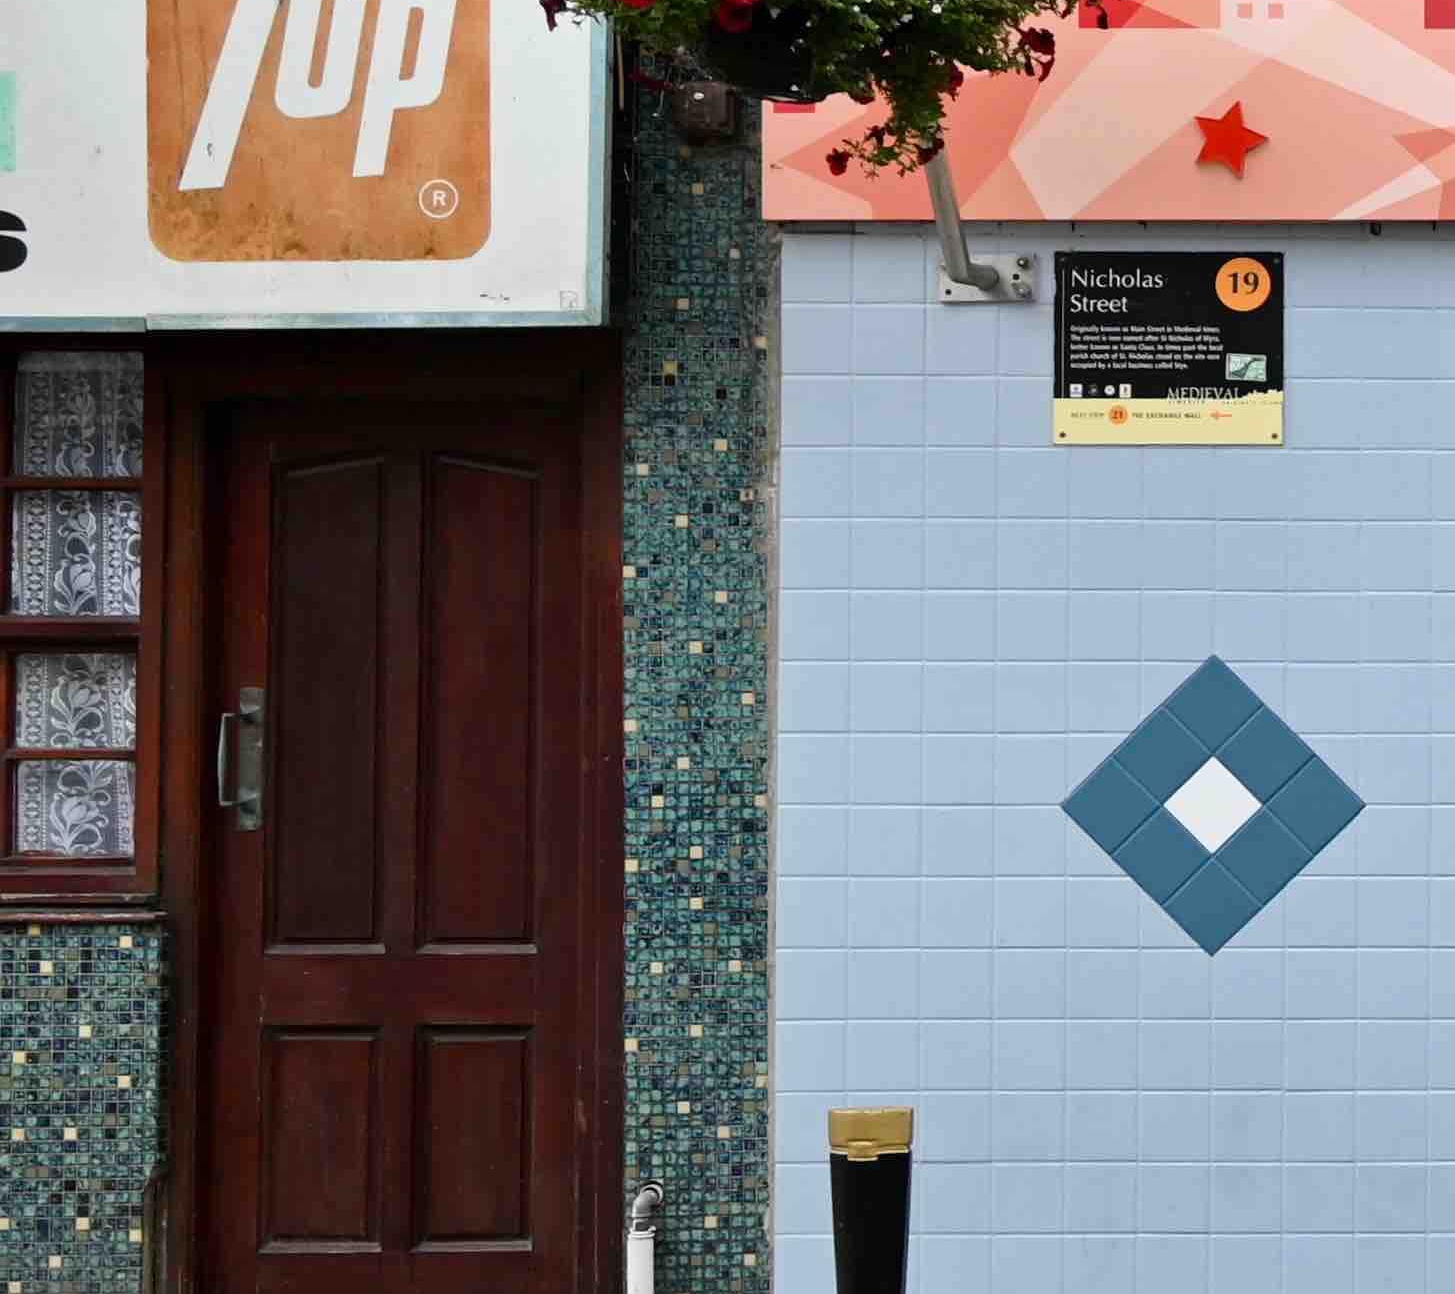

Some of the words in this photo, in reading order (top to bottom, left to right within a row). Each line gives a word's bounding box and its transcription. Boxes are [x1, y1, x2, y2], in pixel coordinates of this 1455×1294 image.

[1071, 268, 1164, 289] Nicholas
[1228, 271, 1260, 295] 19
[1070, 293, 1128, 313] Street
